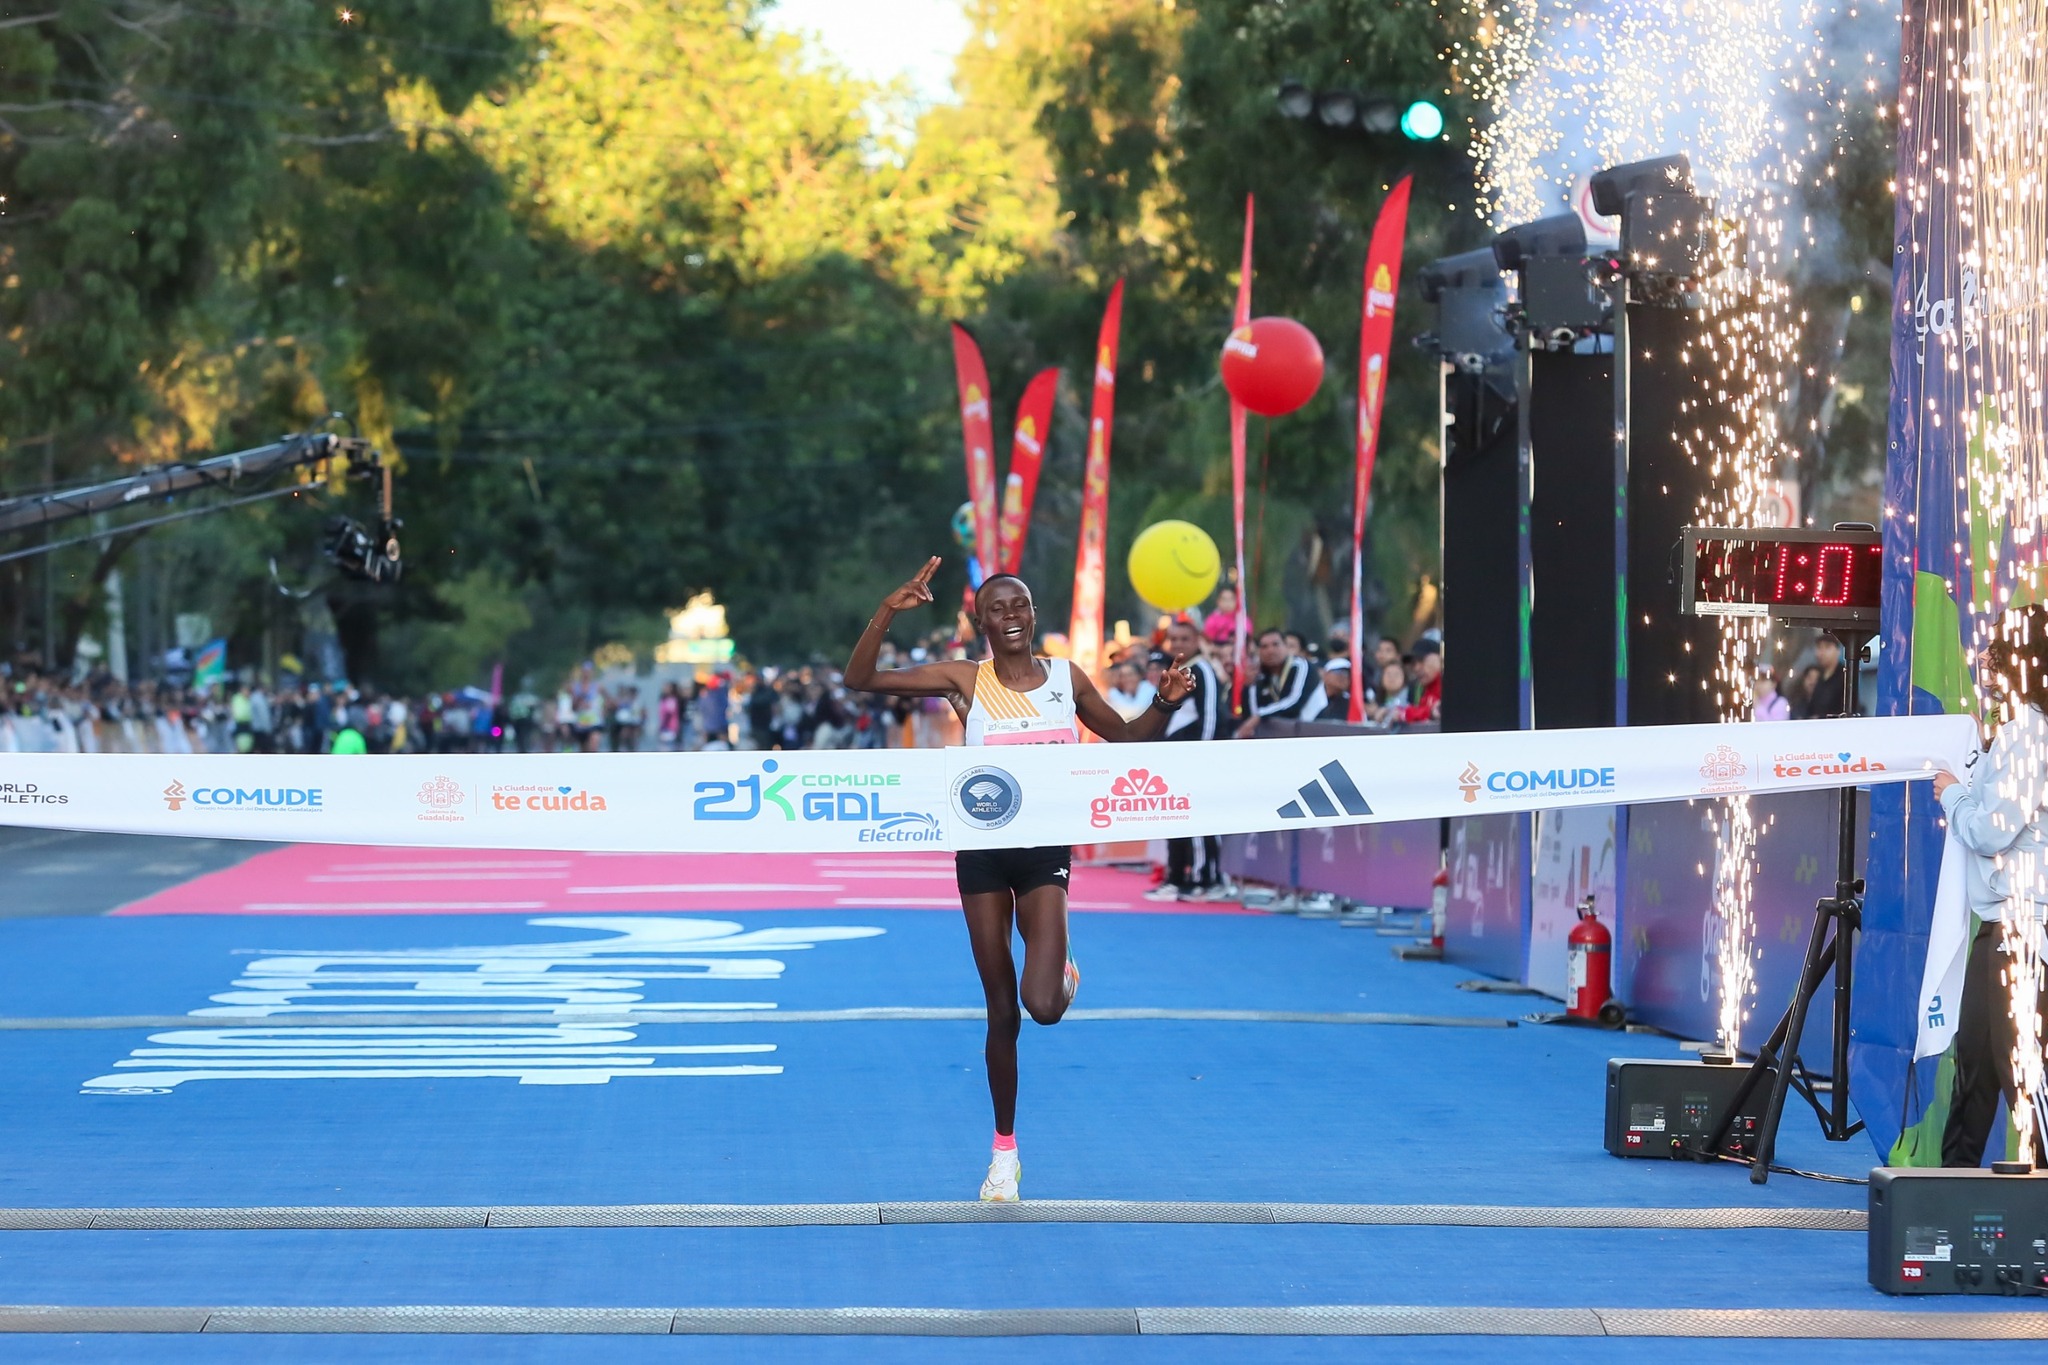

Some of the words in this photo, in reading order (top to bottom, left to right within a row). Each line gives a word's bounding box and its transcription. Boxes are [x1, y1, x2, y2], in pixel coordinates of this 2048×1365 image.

[1774, 545, 1882, 604] 1:0
[1774, 754, 1784, 762] La
[1785, 752, 1816, 761] Ciudad
[1818, 753, 1834, 762] que
[967, 768, 985, 777] LABEL
[1773, 763, 1802, 778] te
[1807, 757, 1887, 776] cuida
[0, 783, 38, 793] RLD
[801, 773, 901, 787] COMUDE
[1487, 767, 1615, 792] COMUDE
[192, 787, 323, 806] COMUDE
[492, 792, 521, 811] te
[526, 790, 607, 811] cuida
[693, 773, 799, 822] 21K
[802, 791, 903, 822] GDL
[1090, 794, 1191, 828] granvita
[417, 814, 465, 823] Guadalajara
[986, 818, 1003, 828] ROAD
[1001, 809, 1015, 822] RACE
[858, 828, 943, 843] Electrolit
